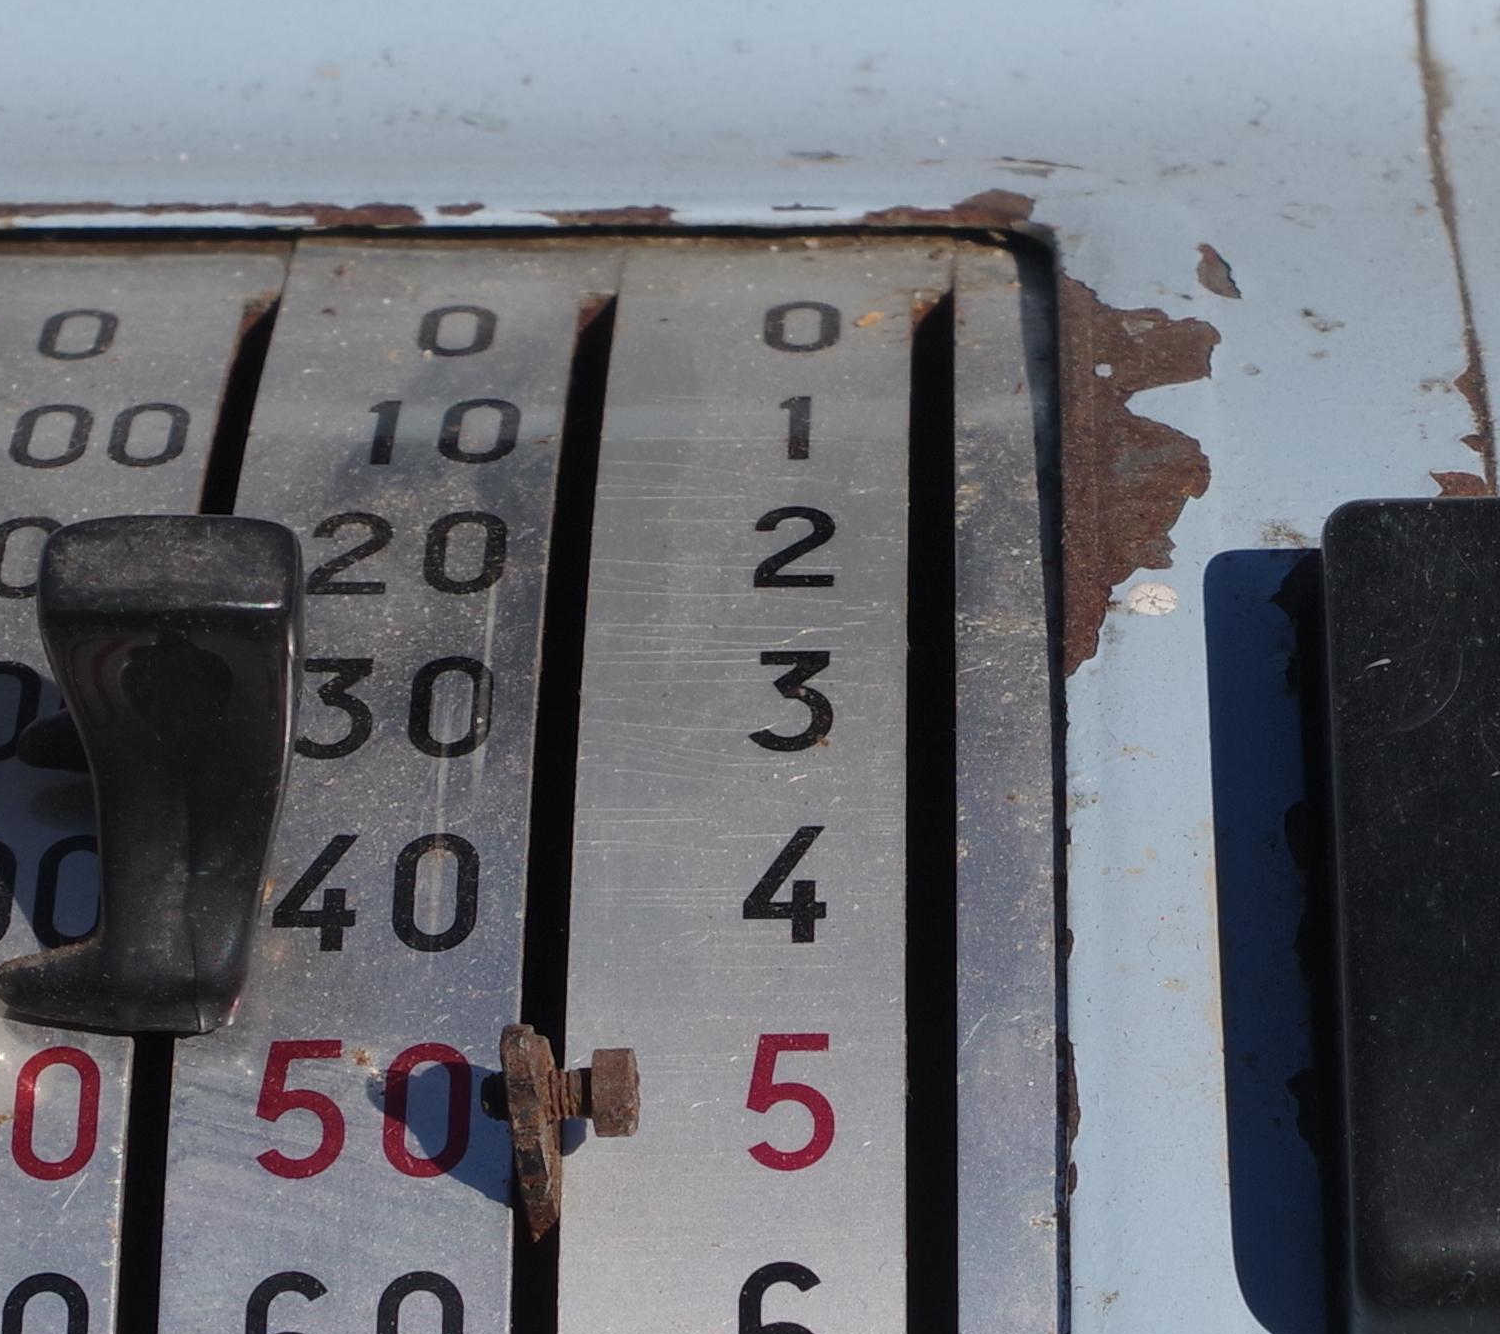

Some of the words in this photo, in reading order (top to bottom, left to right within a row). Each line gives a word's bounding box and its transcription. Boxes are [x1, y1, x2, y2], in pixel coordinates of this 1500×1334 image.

[37, 310, 119, 361] 0
[417, 306, 497, 358] 0
[763, 302, 841, 353] 0
[366, 397, 521, 465] 10
[780, 396, 811, 461] 1
[306, 510, 510, 597] 20
[754, 506, 836, 588] 2
[293, 659, 495, 761] 30
[749, 651, 833, 752] 3
[272, 834, 481, 954] 40
[743, 826, 826, 943] 4
[257, 1040, 466, 1179] 50
[747, 1034, 835, 1171] 5
